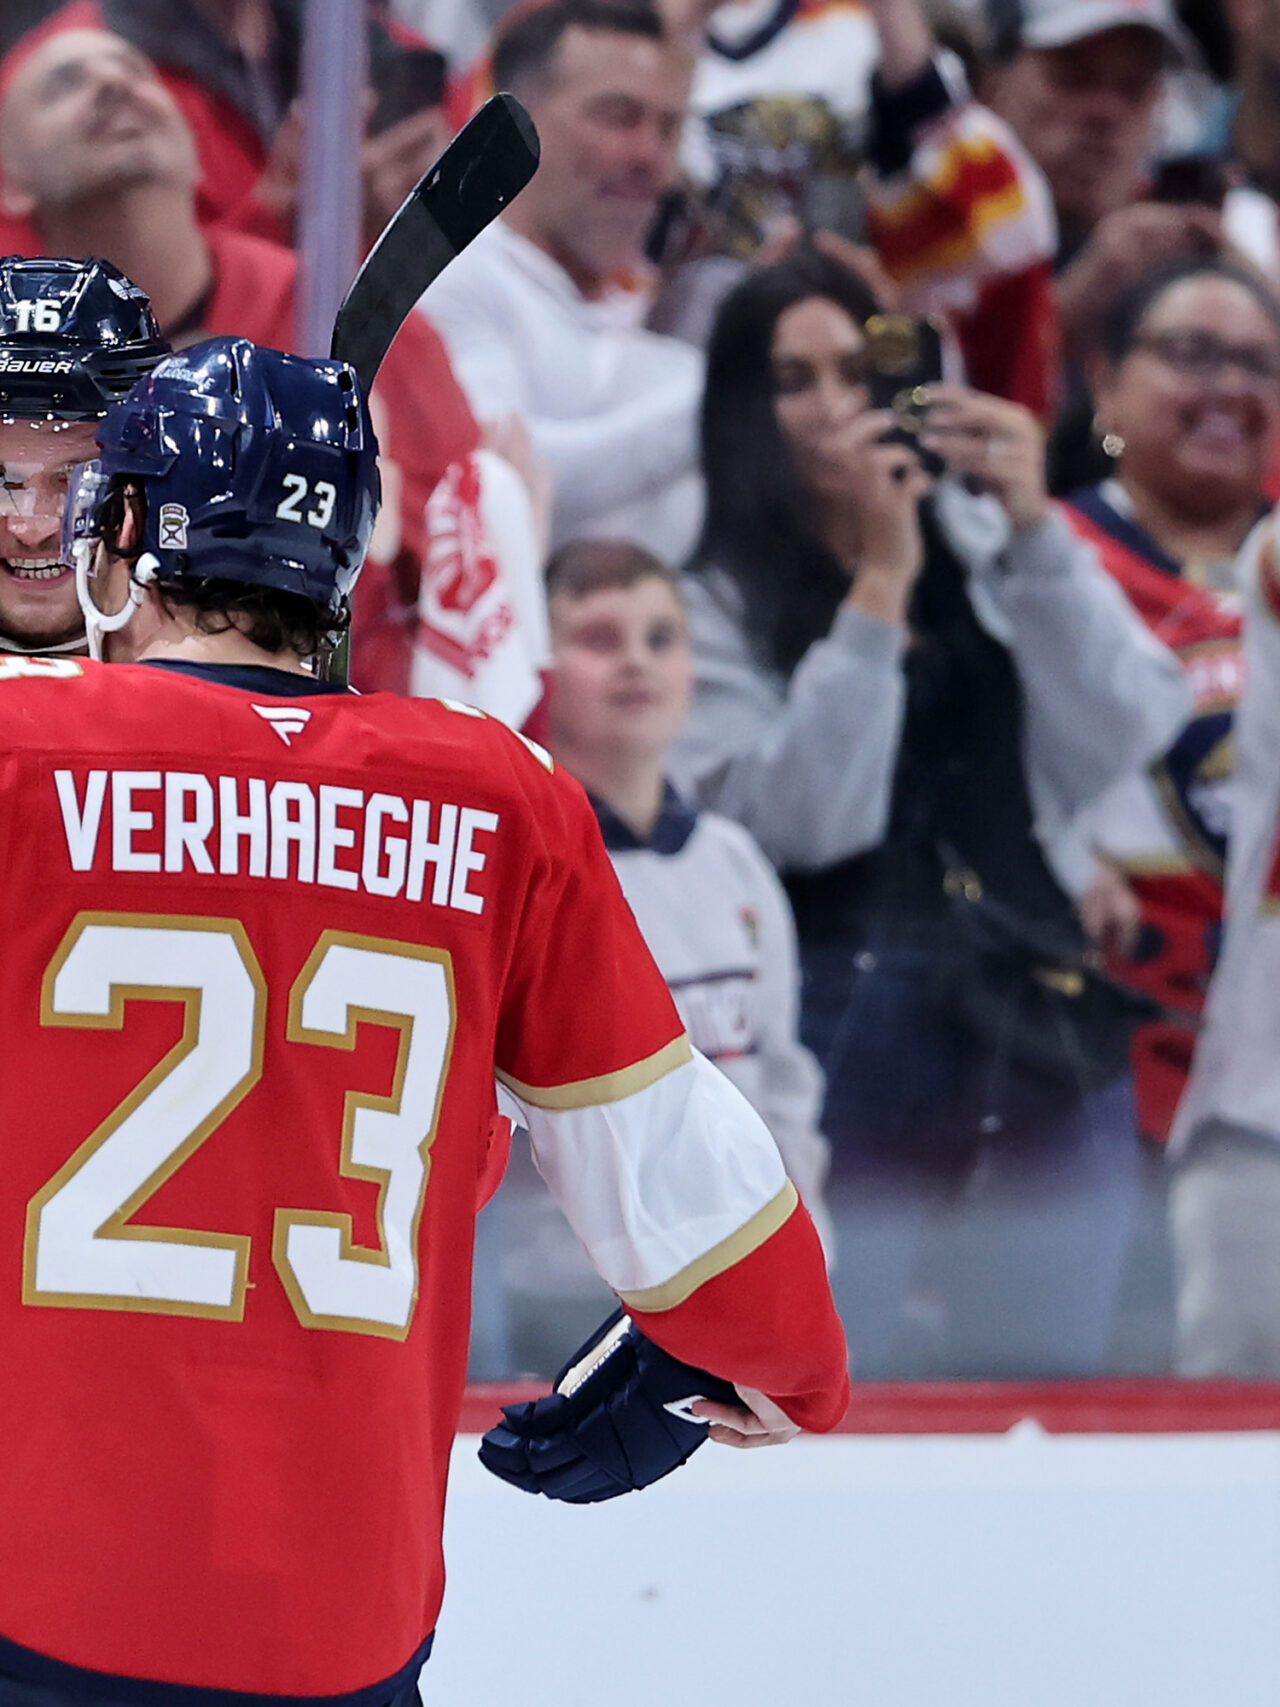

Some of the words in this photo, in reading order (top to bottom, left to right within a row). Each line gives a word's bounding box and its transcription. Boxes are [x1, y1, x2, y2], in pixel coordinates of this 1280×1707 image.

[16, 299, 62, 332] 16
[276, 473, 336, 529] 23
[53, 769, 501, 914] VERHAEGHE
[22, 910, 458, 1342] 23
